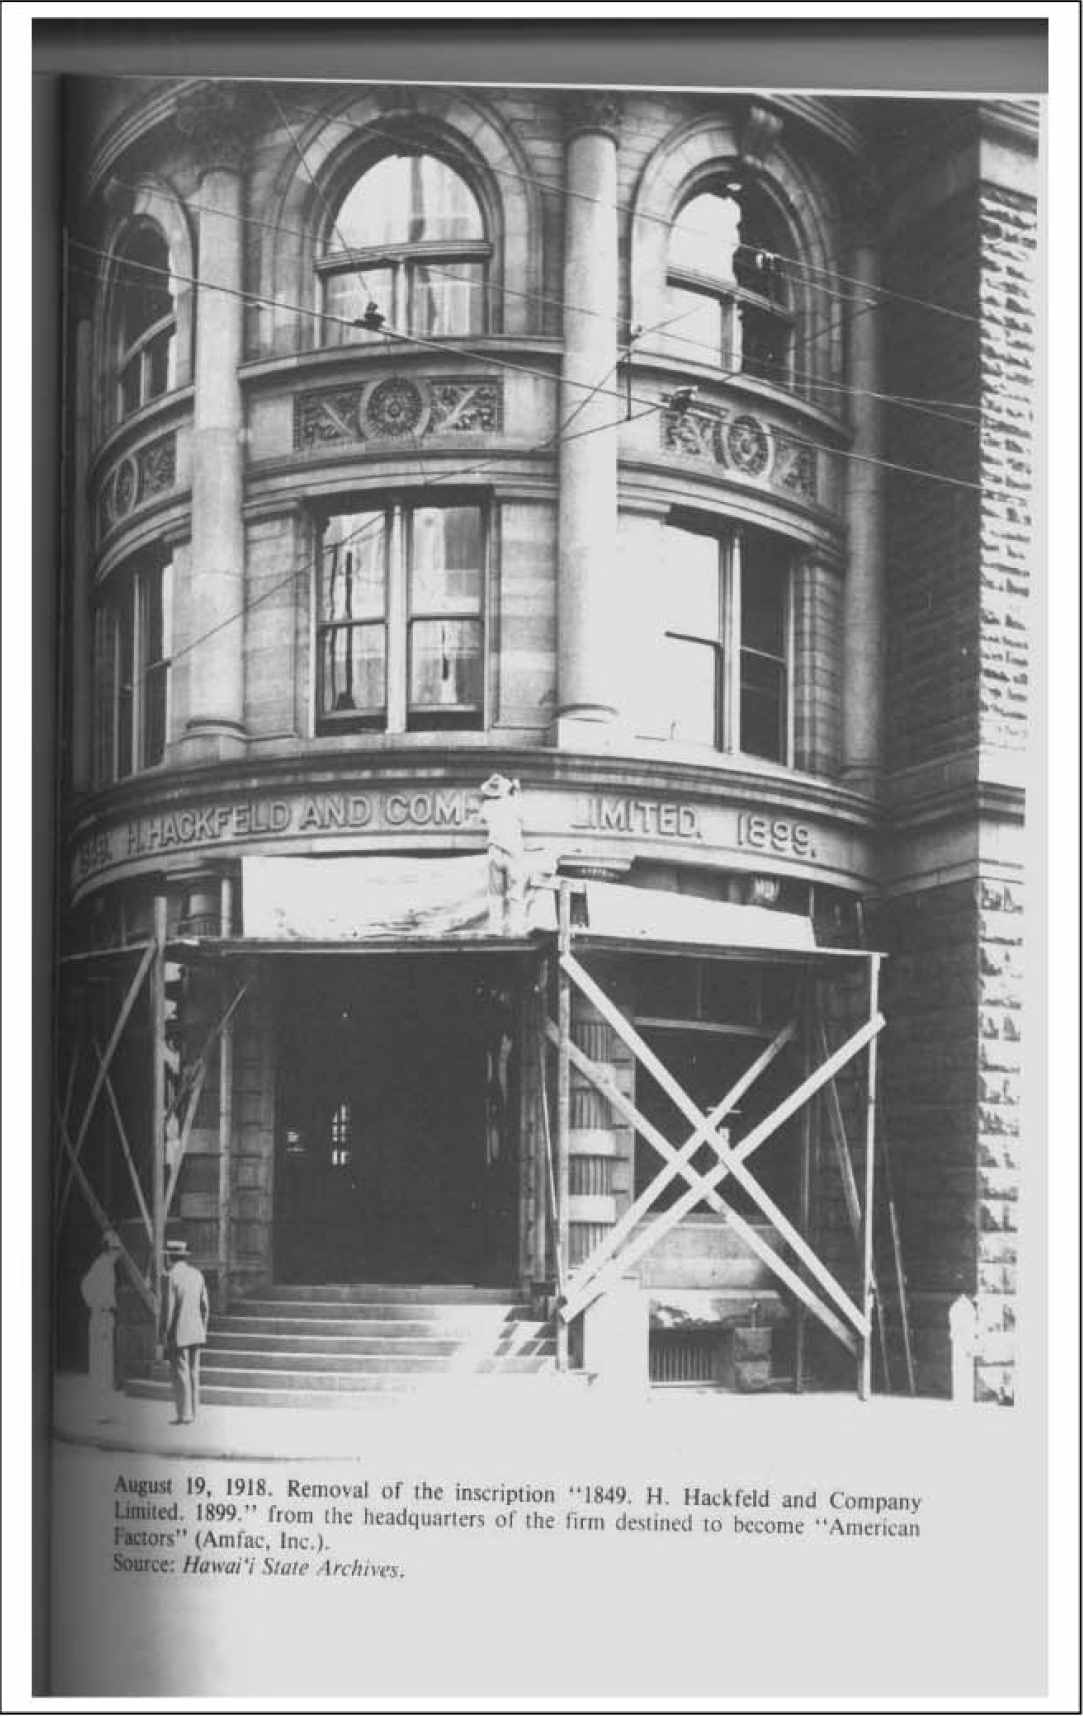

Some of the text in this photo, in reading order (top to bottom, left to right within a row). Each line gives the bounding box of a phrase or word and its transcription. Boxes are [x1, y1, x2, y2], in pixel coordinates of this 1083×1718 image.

[148, 800, 291, 848] HACKFELD
[300, 795, 371, 831] AND
[737, 813, 817, 859] 1899.
